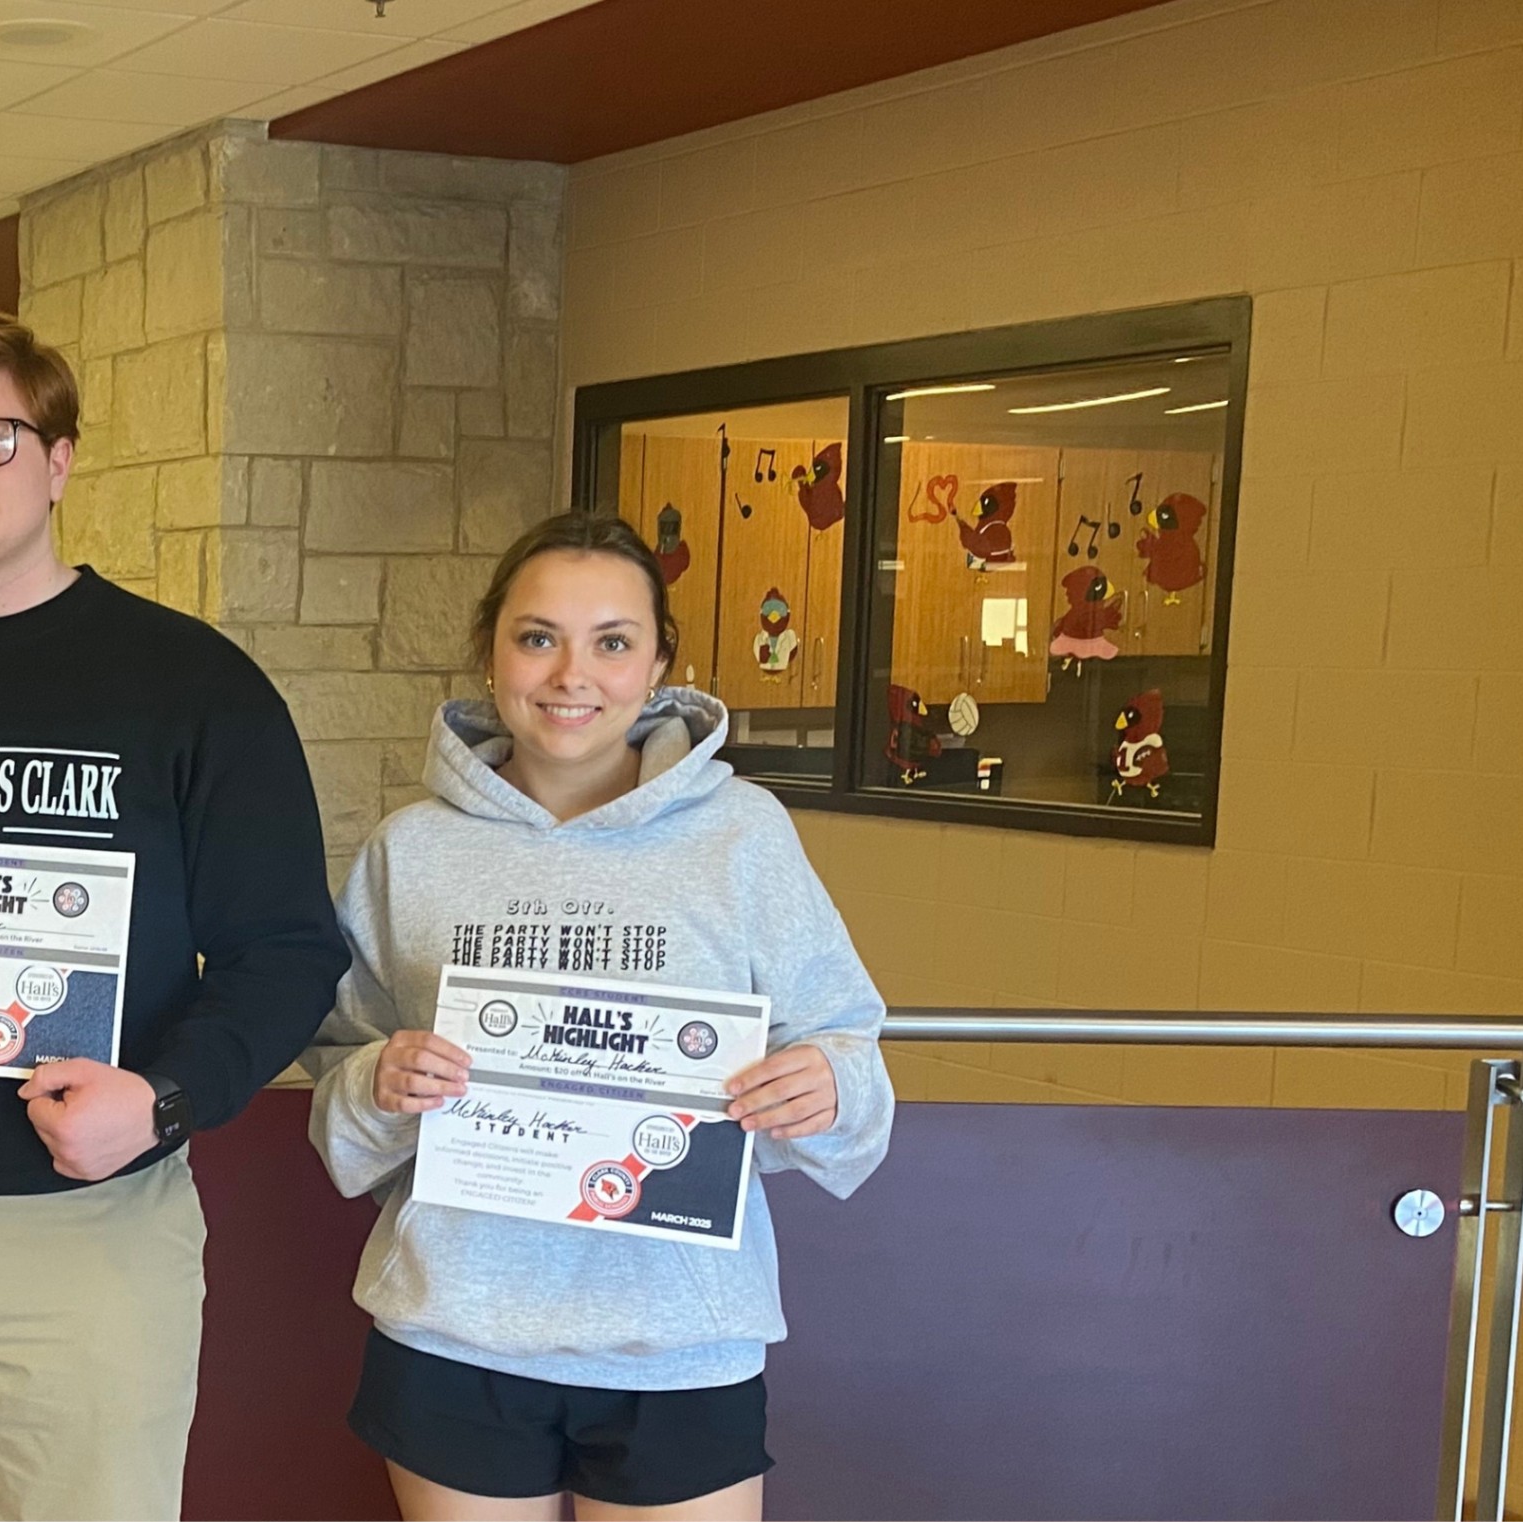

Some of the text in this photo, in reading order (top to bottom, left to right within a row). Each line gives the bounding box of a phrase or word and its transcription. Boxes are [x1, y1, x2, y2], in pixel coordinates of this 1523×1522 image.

[21, 759, 123, 820] CLARK
[454, 924, 667, 937] THE PARTY WON'T STOP
[453, 936, 667, 950] THE PARTY WON'T STOP
[20, 980, 60, 998] Hall's
[563, 1005, 633, 1031] HALL'S
[543, 1024, 649, 1054] HIGHLIGHT
[475, 1120, 570, 1143] STUDENT
[638, 1131, 681, 1151] Hall's
[651, 1211, 712, 1229] MARCH 2025
